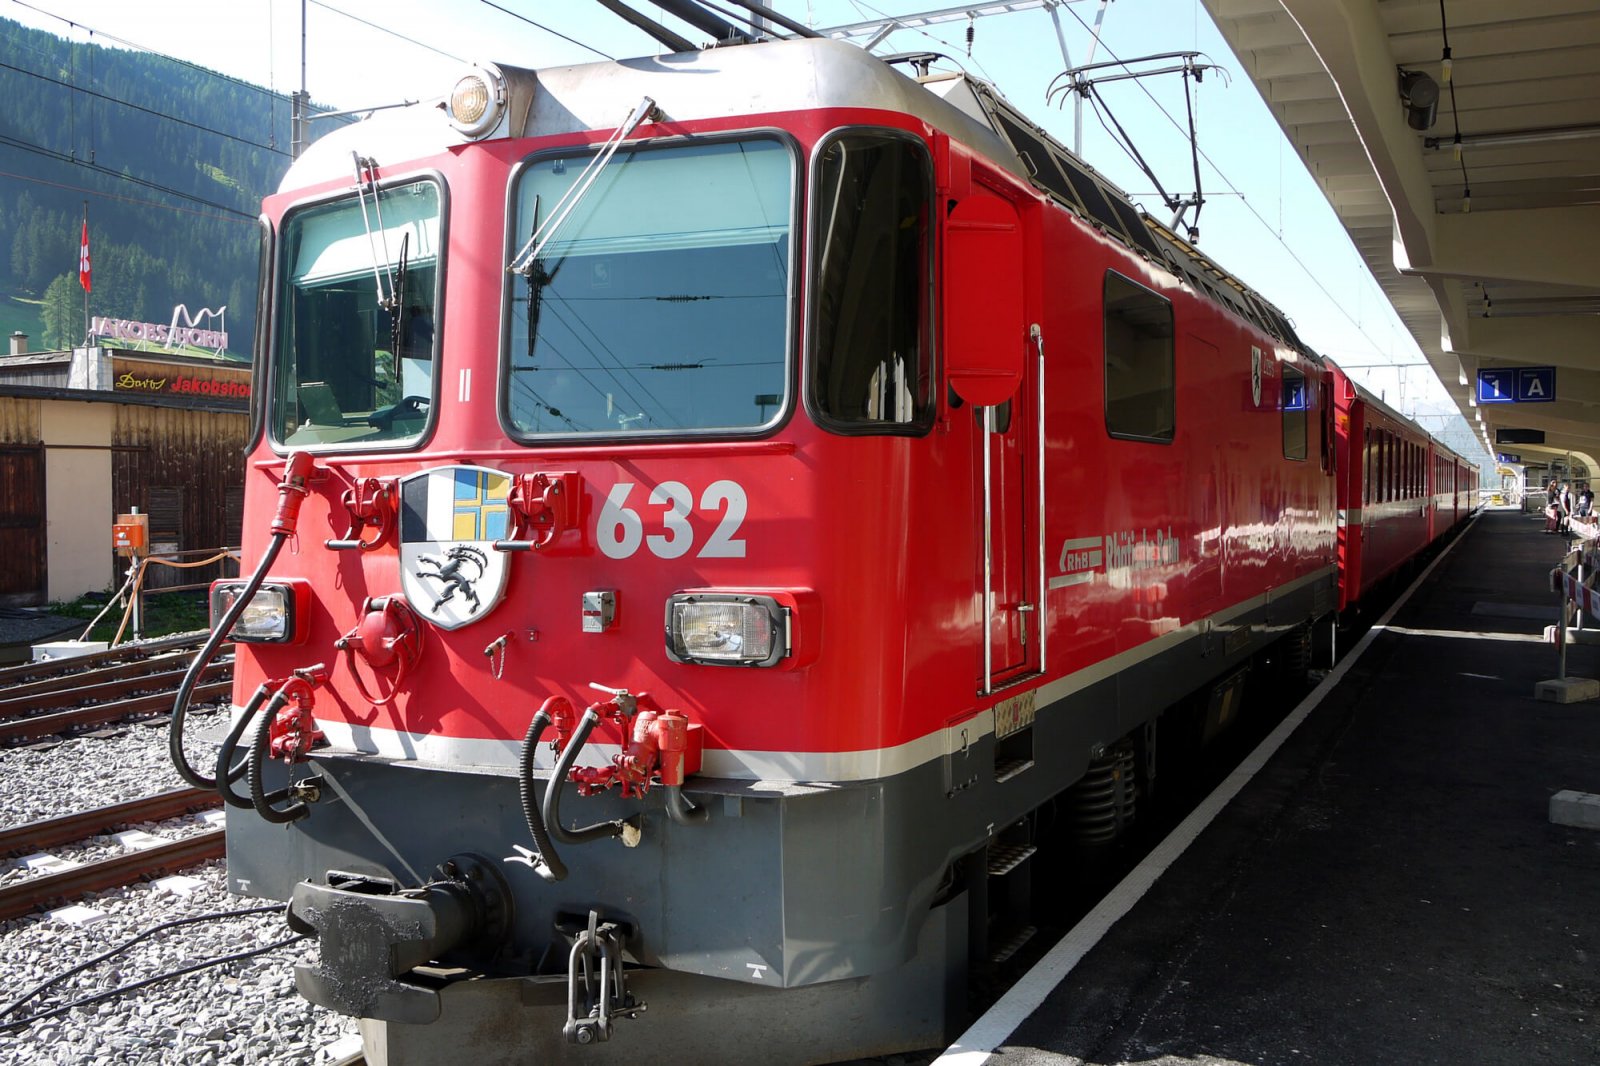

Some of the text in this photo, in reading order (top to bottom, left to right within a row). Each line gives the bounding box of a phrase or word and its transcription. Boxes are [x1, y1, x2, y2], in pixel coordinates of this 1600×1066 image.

[116, 371, 166, 389] Davos
[1492, 378, 1544, 397] 1 A
[596, 480, 748, 560] 632
[1067, 552, 1089, 572] RhB
